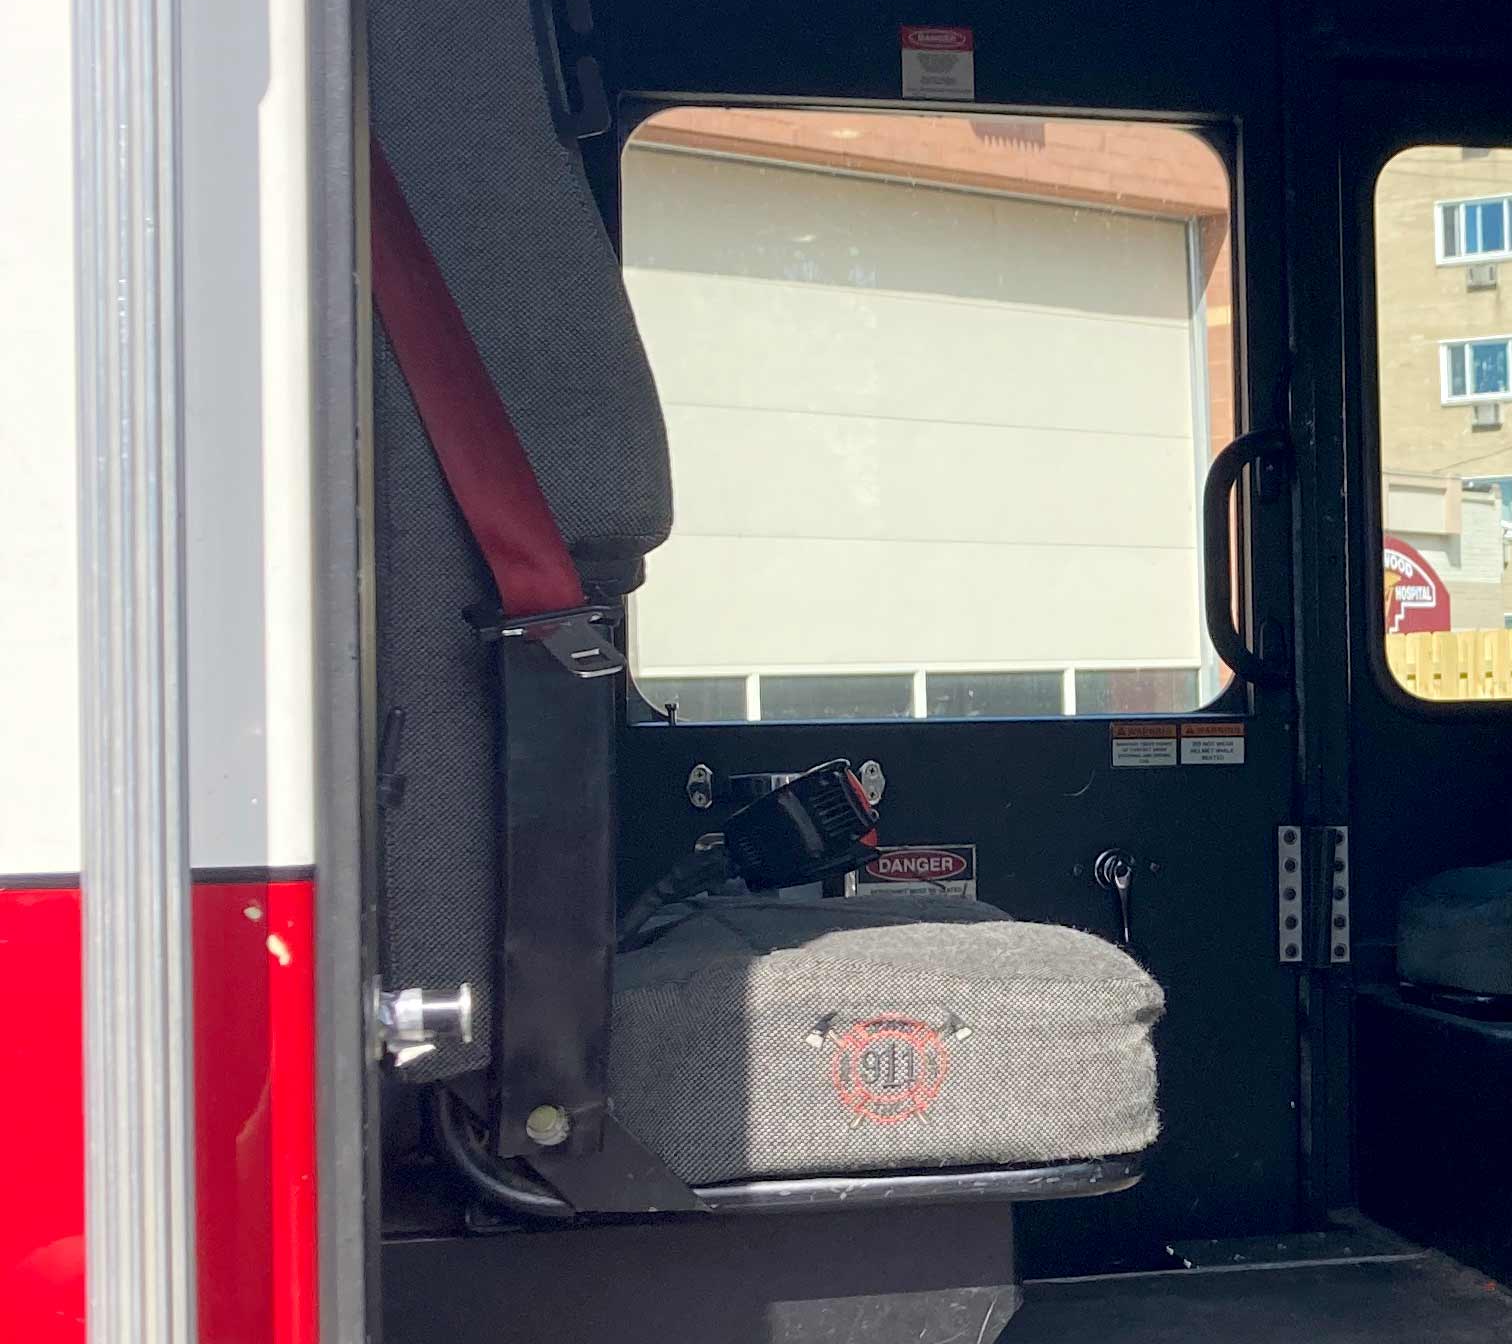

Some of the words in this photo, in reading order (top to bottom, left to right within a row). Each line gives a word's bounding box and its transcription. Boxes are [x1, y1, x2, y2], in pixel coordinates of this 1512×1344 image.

[1395, 585, 1433, 601] HOSPITAL
[878, 857, 953, 874] DANGER
[862, 1040, 915, 1089] 911
